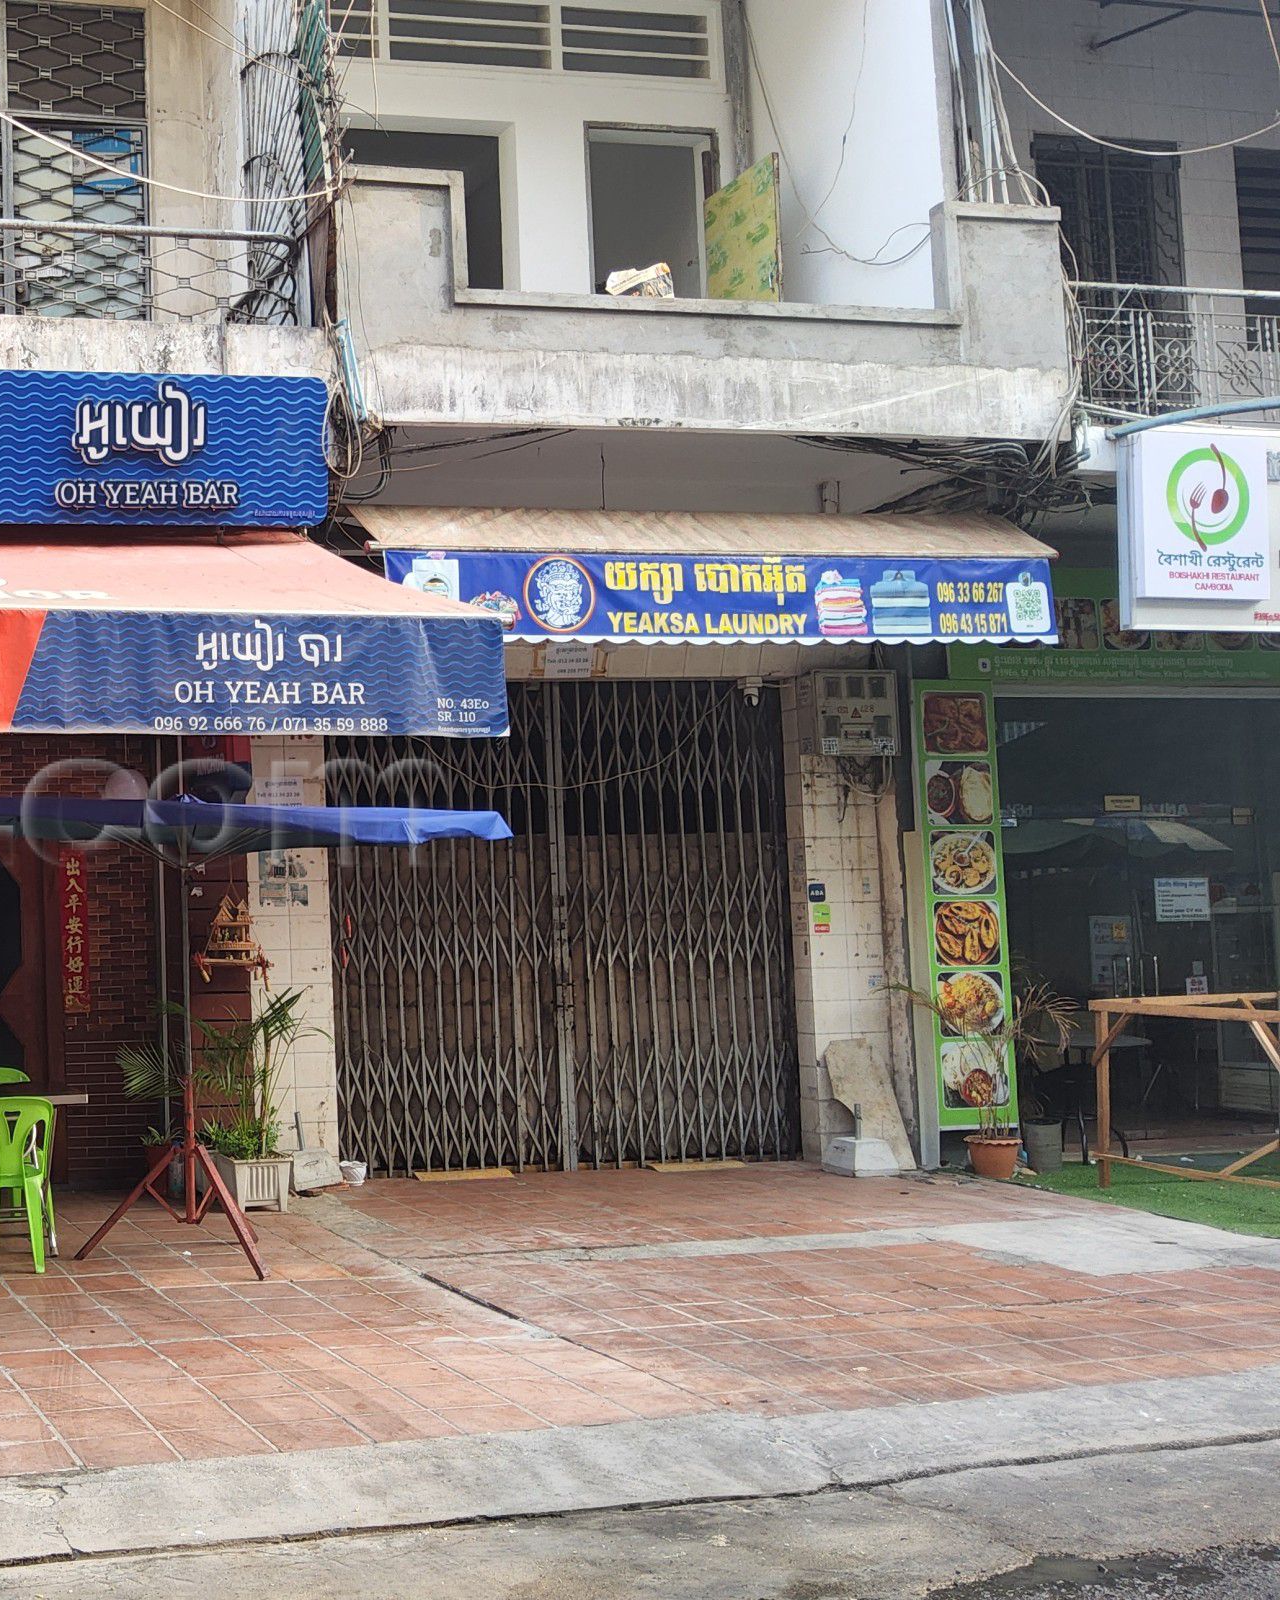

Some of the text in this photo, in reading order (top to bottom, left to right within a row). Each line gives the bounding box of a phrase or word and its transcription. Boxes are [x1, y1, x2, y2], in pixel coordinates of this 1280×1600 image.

[60, 482, 239, 506] OH YEAH BAR
[1157, 549, 1203, 567] বৈশাখী
[1168, 571, 1260, 582] BOISHAKHI RESTAURANT
[936, 581, 1004, 603] 096 33 66 267
[1194, 583, 1234, 591] CAMBODIA
[606, 611, 808, 635] YEAKSA LAUNDRY
[939, 613, 1008, 634] 096 43 15 871
[174, 681, 365, 706] OH YEAH BAR
[437, 697, 490, 710] NO. 43Eo
[154, 717, 388, 732] 096 92 666 76 / 071 35 59 888
[459, 711, 476, 722] 110
[64, 857, 85, 994] 出入平安行好運
